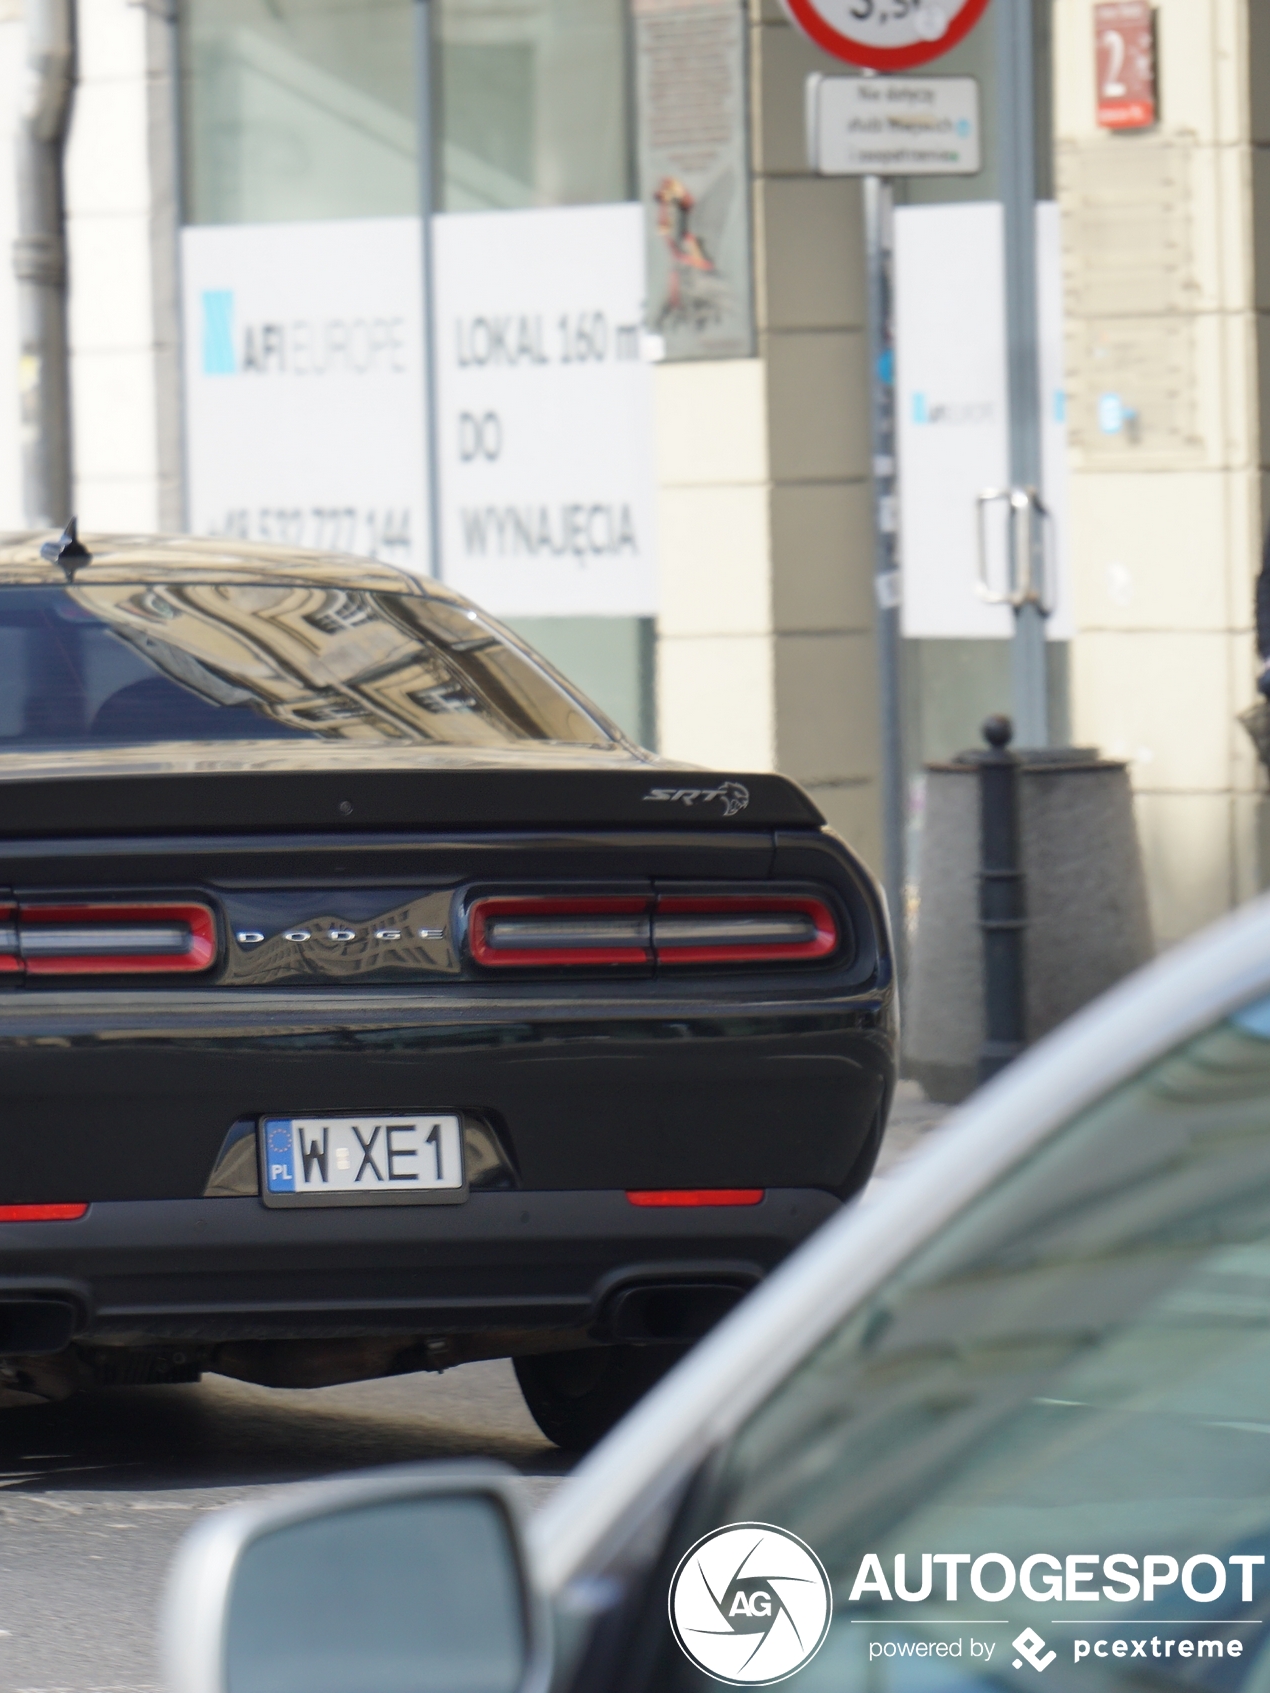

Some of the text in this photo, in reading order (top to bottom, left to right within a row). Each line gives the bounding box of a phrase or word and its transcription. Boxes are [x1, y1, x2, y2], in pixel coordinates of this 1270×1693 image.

[456, 314, 549, 369] LOKAL
[558, 310, 607, 365] 160
[459, 410, 502, 464] DO
[460, 503, 640, 569] WYNAJĘCIA
[643, 788, 728, 807] SRT
[237, 928, 447, 944] DODGE
[271, 1163, 293, 1181] PL
